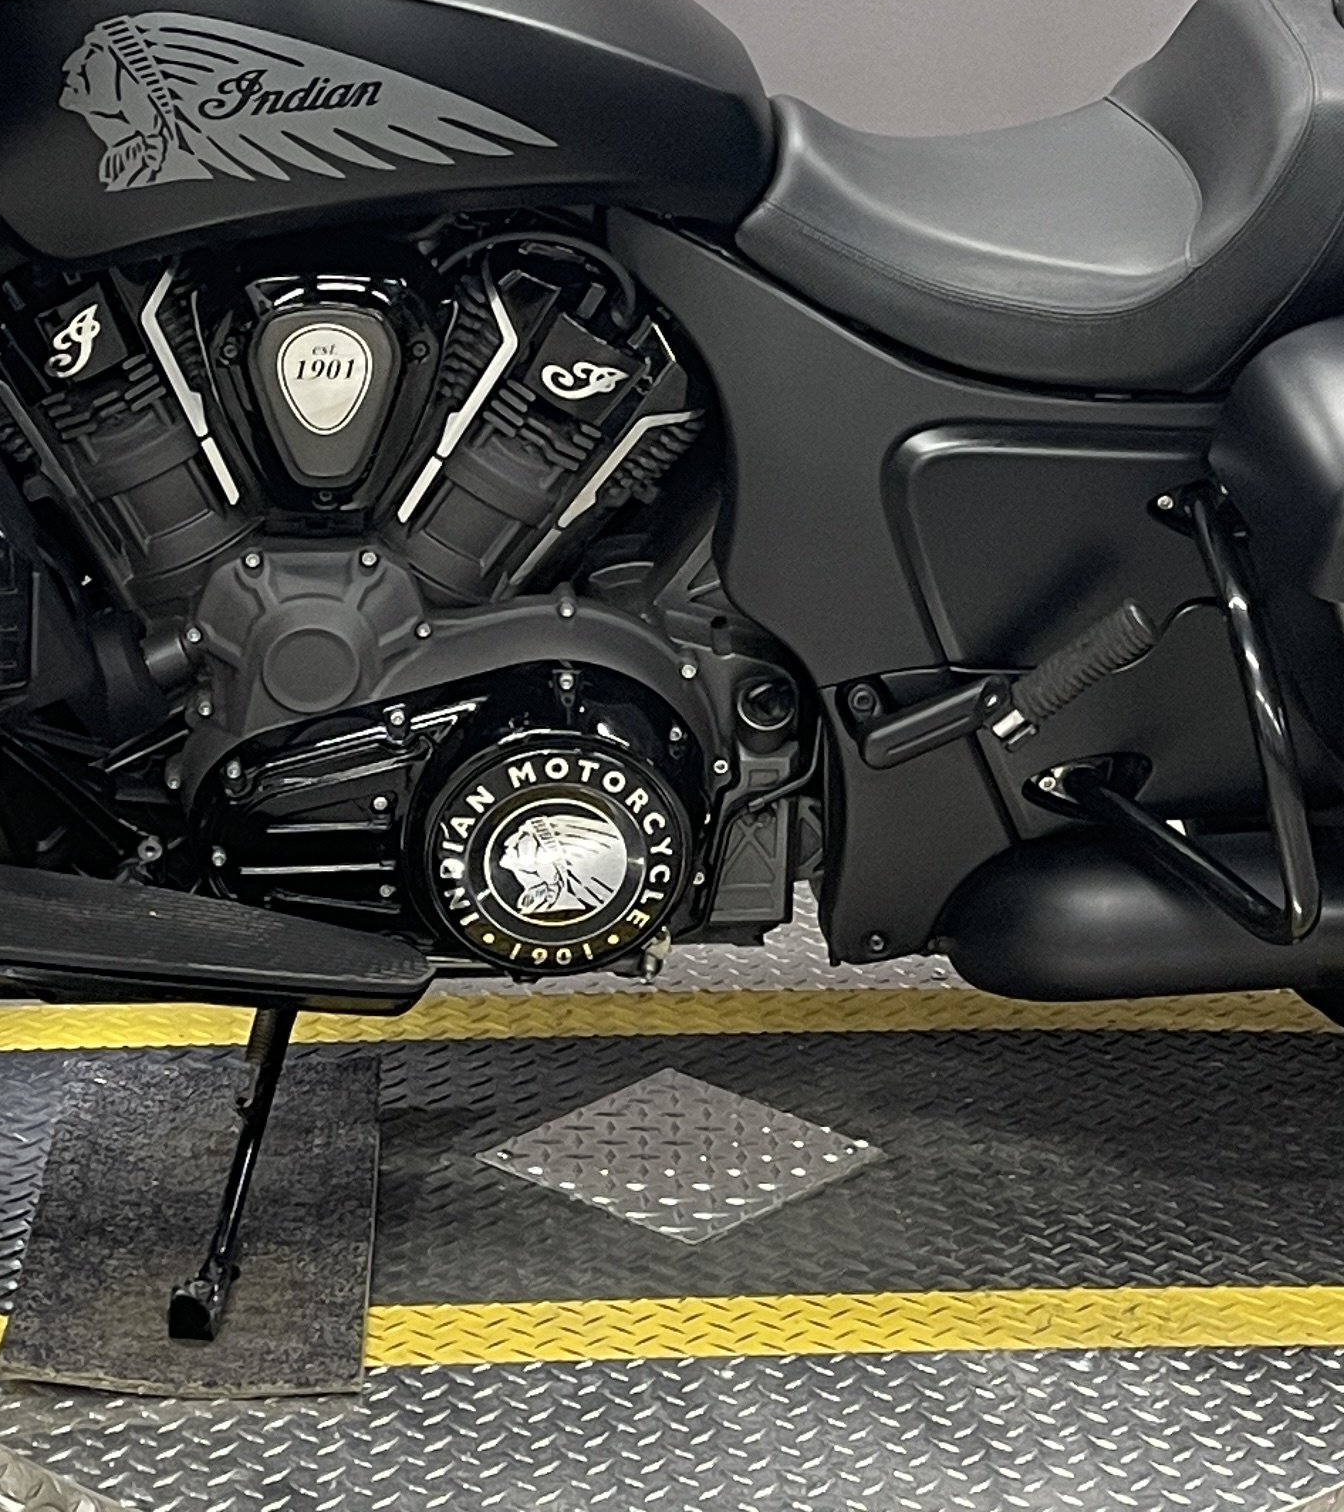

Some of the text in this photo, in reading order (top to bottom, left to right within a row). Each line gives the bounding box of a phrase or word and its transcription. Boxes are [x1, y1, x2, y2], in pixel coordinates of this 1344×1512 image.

[198, 68, 383, 121] Indian
[294, 359, 356, 380] 1901
[440, 757, 674, 929] INDIAN MOTORCYCLE
[508, 942, 594, 966] 1901
